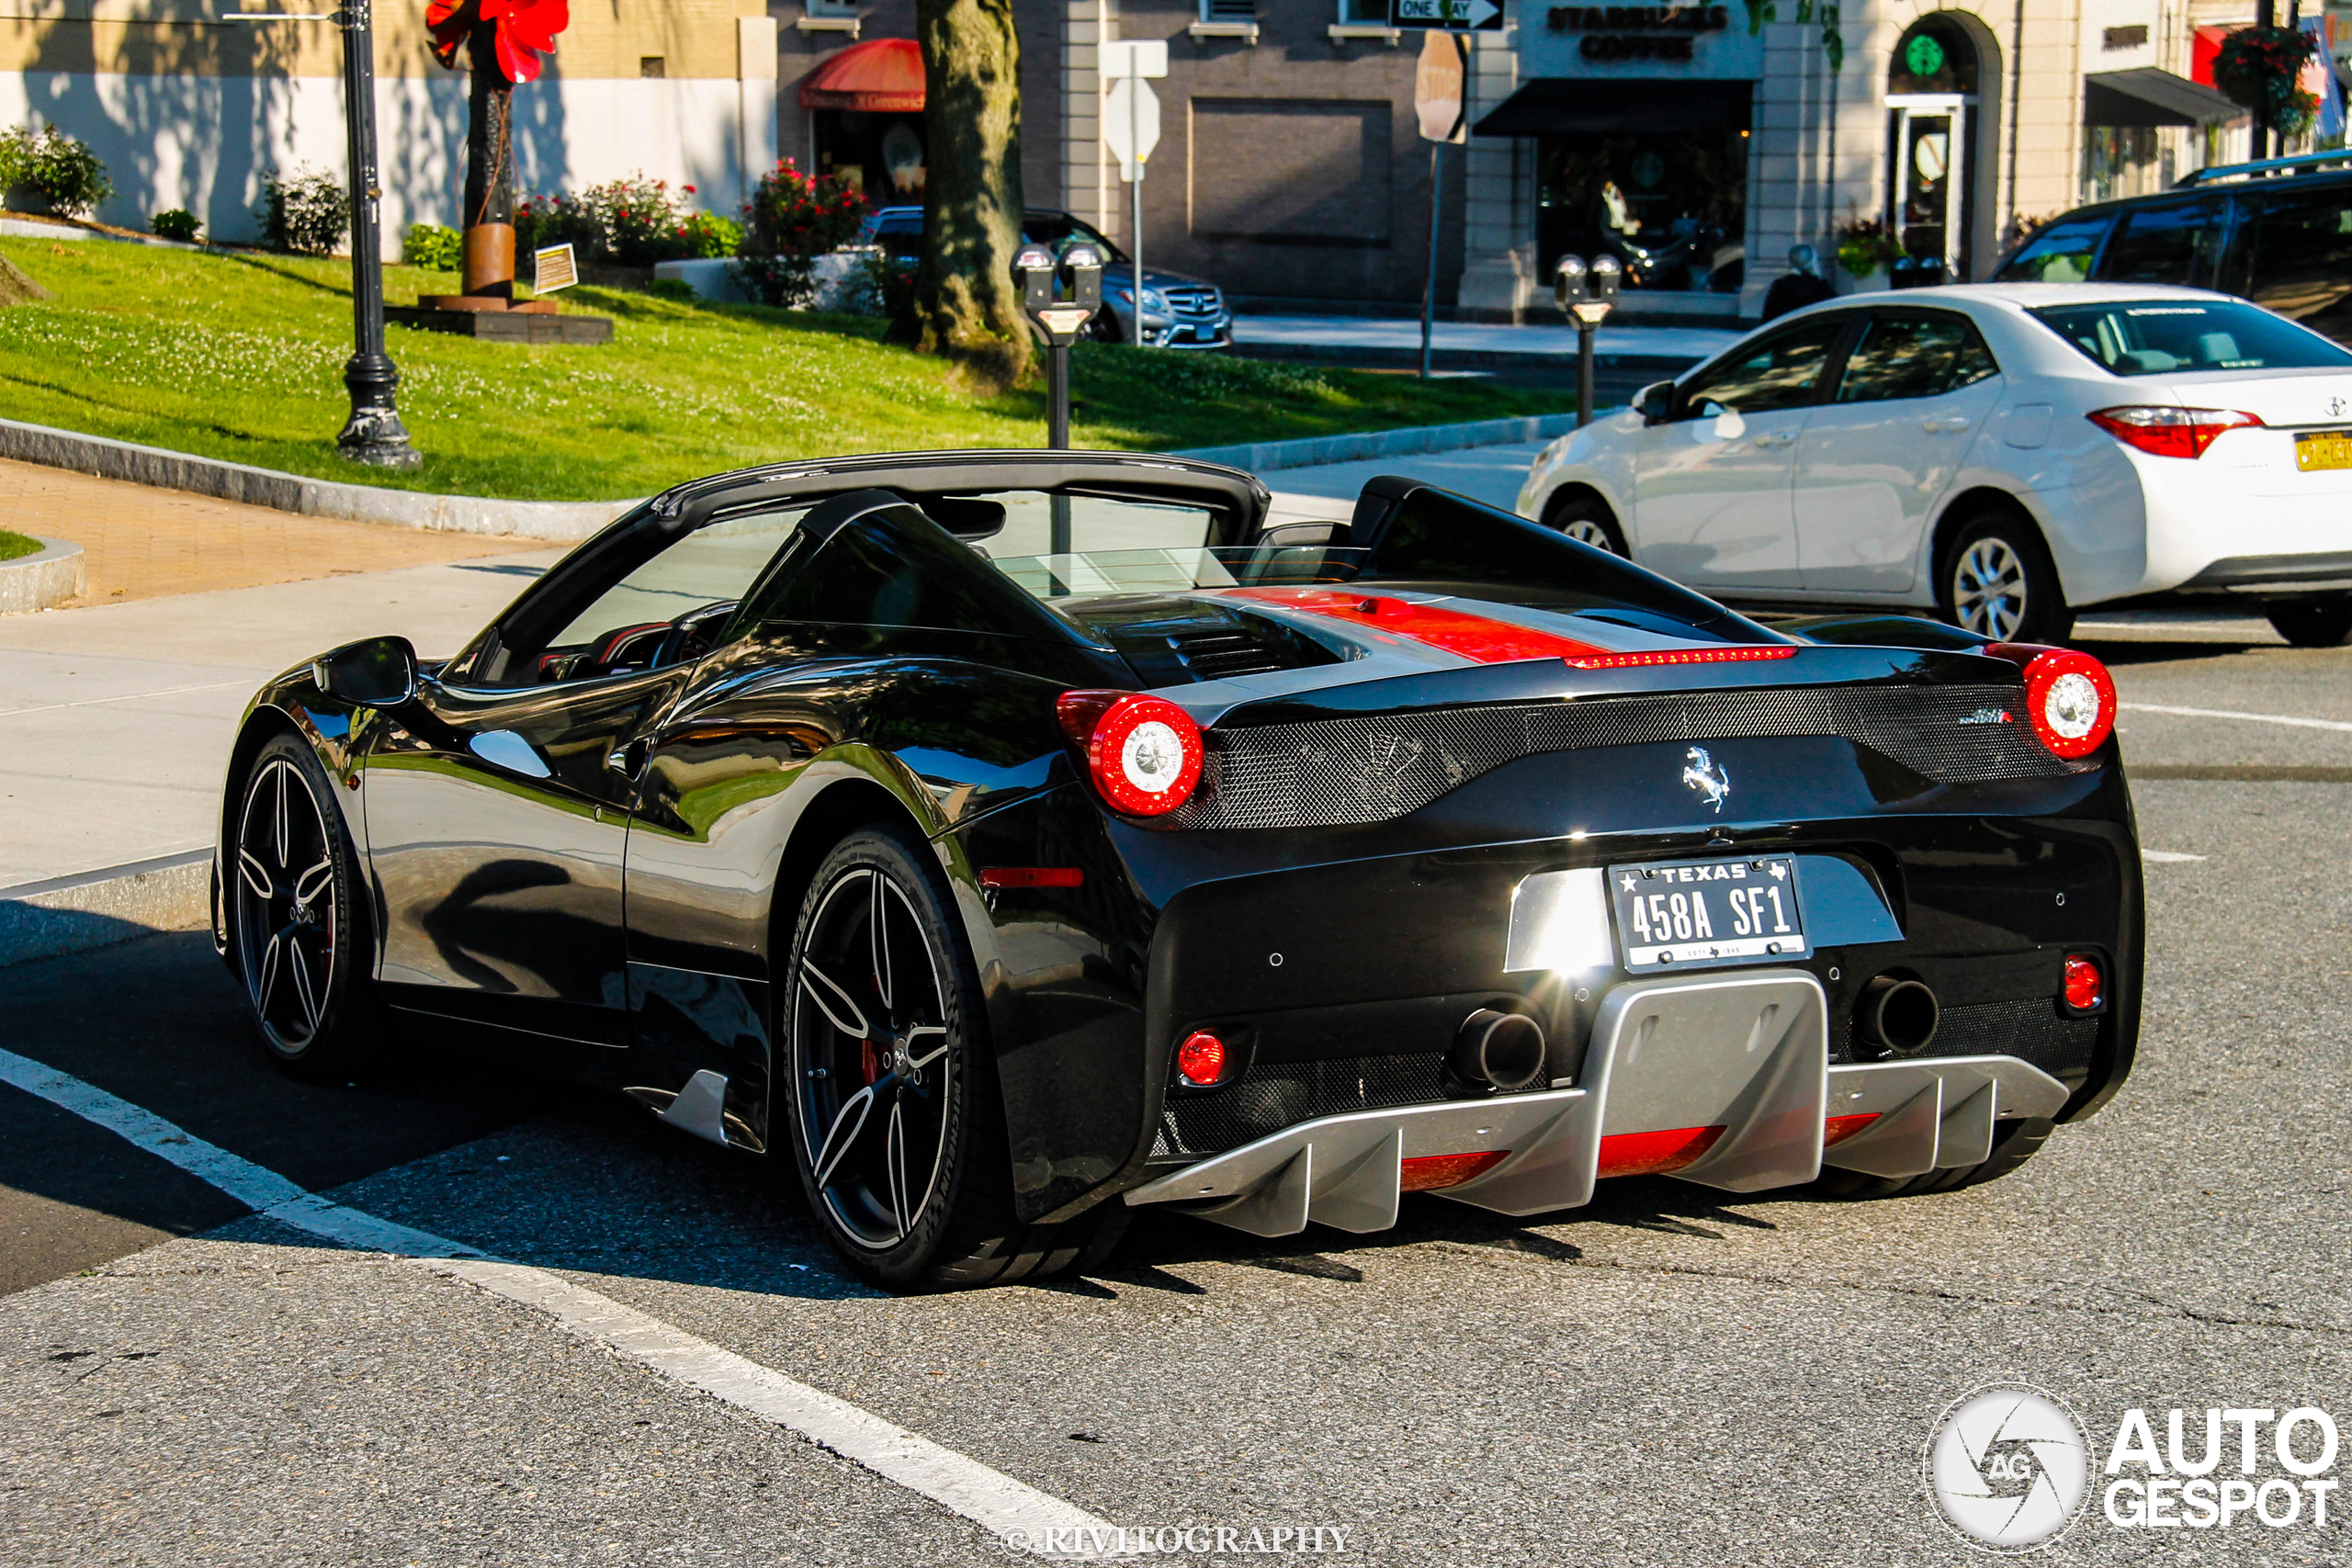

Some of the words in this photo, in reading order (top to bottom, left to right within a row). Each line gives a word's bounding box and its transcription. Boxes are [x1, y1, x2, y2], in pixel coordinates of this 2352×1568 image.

[1403, 1, 1432, 16] ONE
[1547, 6, 1727, 30] STARBUCKS
[1580, 35, 1694, 60] COFFEE
[1421, 65, 1458, 101] STOP
[1661, 864, 1747, 884] TEXAS
[1632, 891, 1714, 943] 458A
[1728, 886, 1792, 935] SF1
[938, 1080, 961, 1198] MICHELIN
